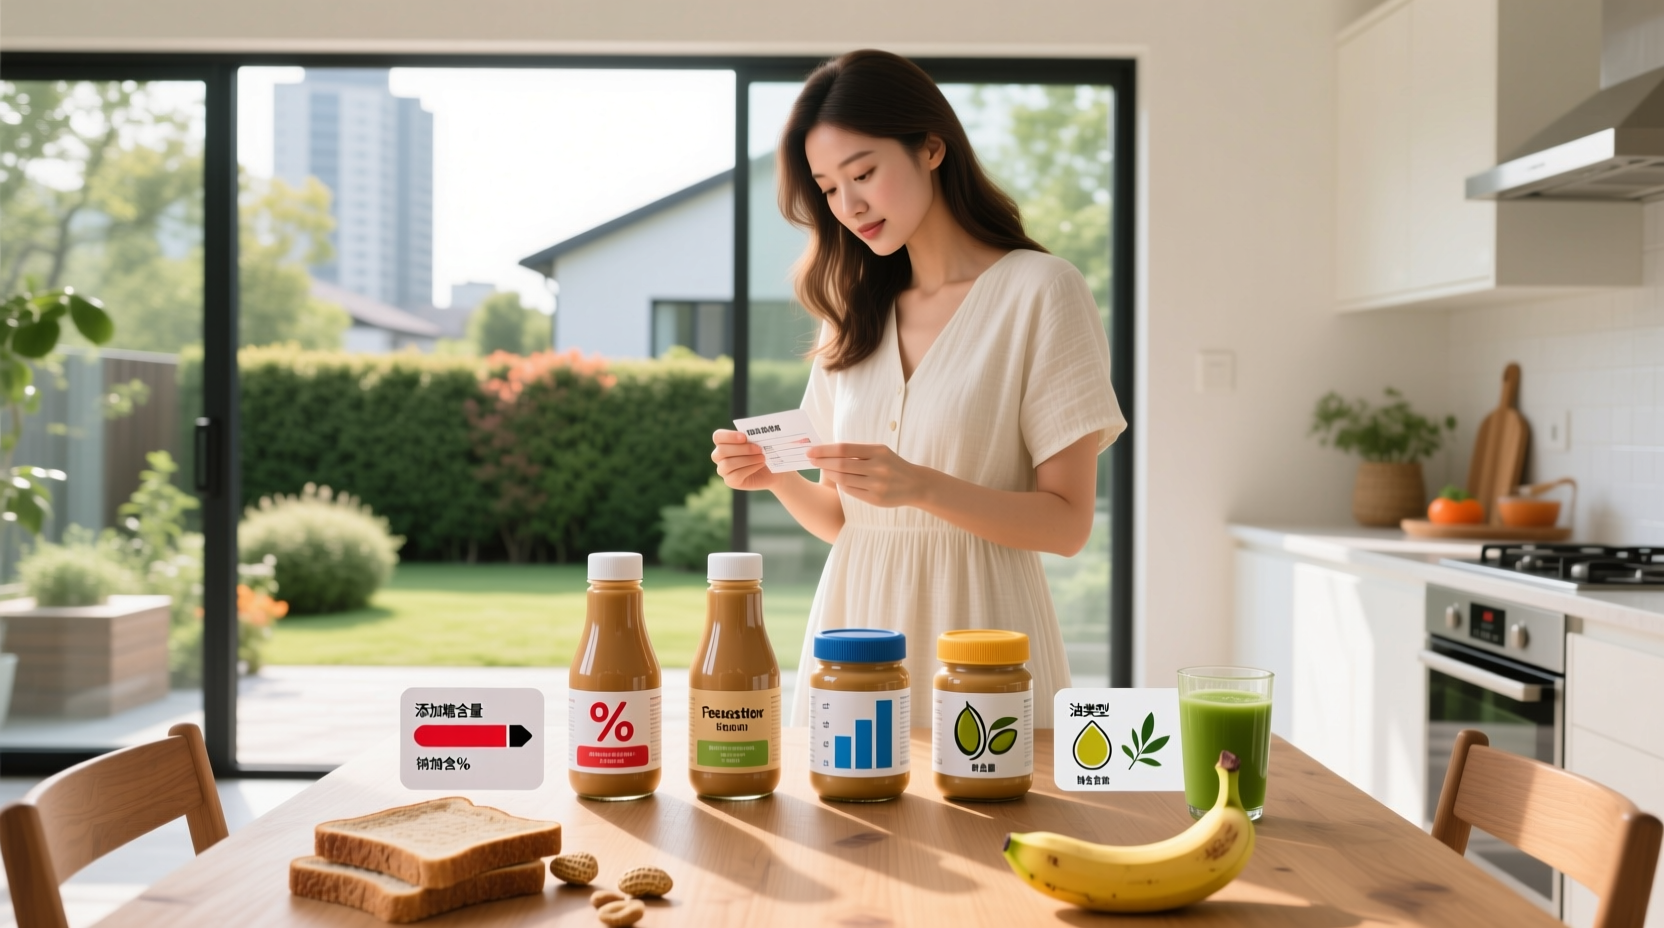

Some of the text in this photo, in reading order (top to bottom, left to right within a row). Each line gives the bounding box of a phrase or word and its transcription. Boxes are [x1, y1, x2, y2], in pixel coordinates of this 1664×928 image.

[415, 703, 483, 719] 添加糖含量
[590, 701, 634, 742] %
